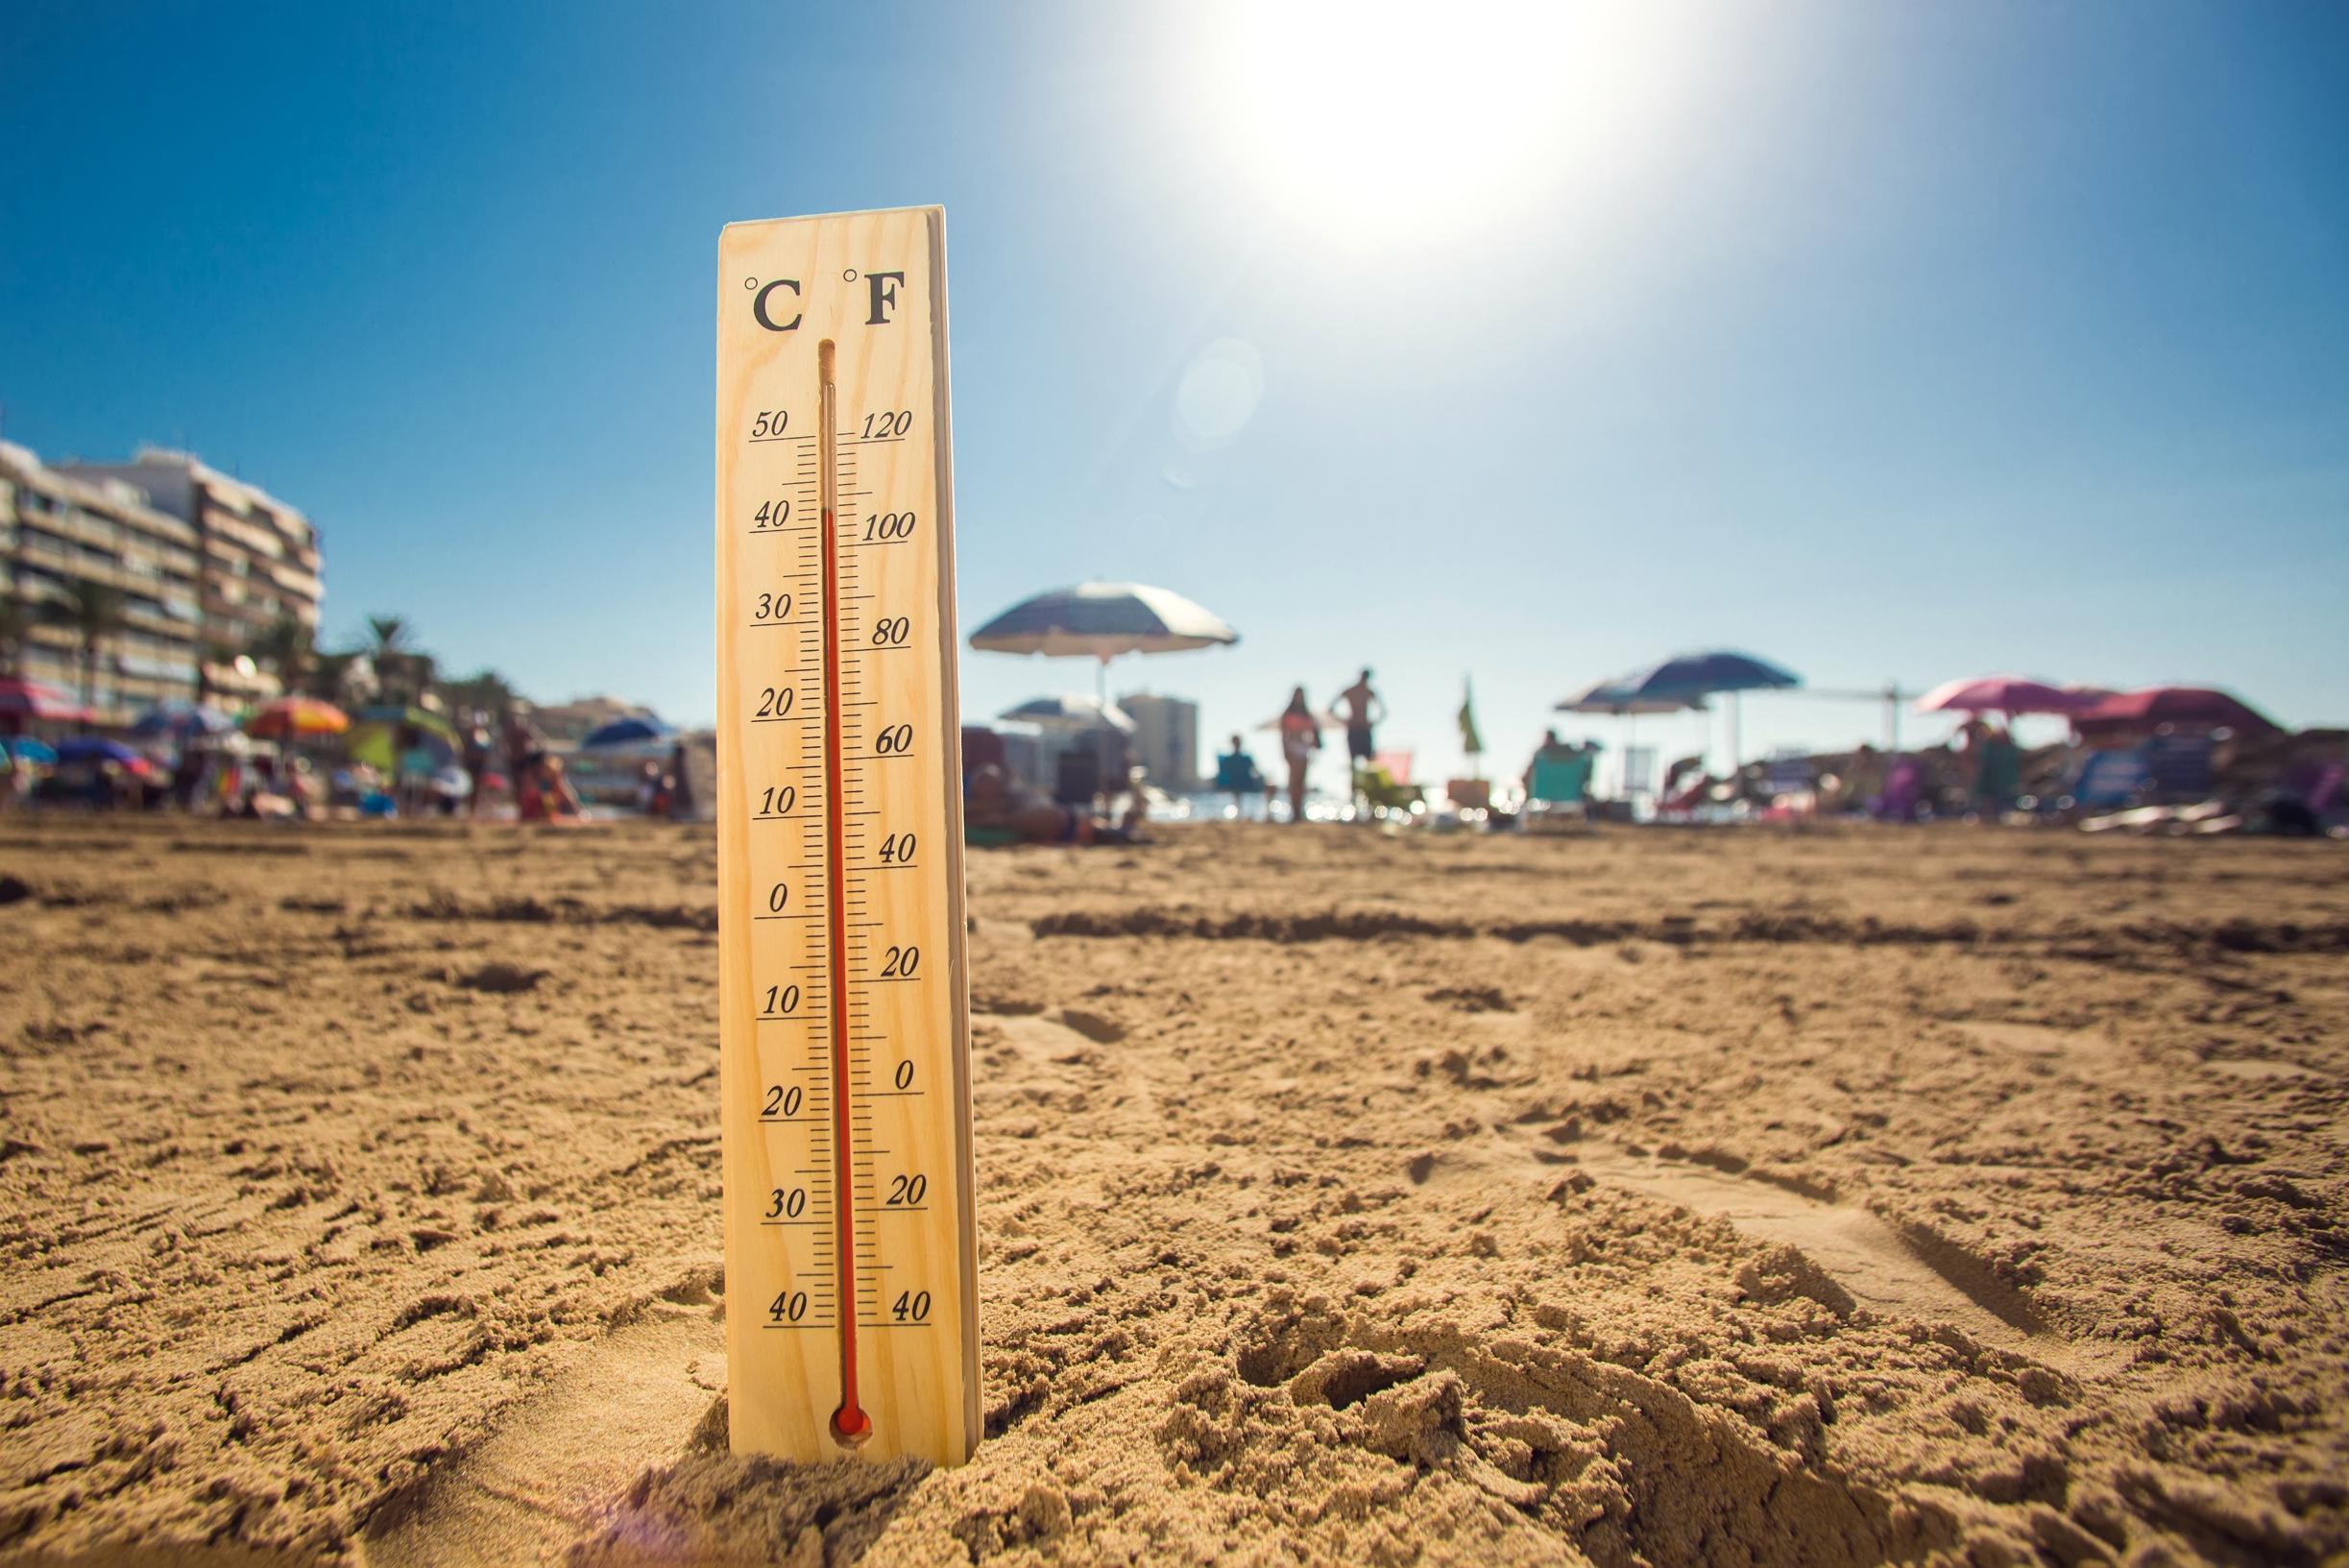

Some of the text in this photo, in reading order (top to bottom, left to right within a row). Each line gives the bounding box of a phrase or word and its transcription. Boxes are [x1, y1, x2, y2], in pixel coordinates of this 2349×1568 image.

[752, 410, 788, 438] 50
[860, 410, 912, 439] 120
[754, 499, 789, 528] 40
[862, 512, 916, 542] 100
[755, 592, 791, 619] 30
[871, 616, 909, 645] 80
[756, 688, 793, 717] 20
[875, 724, 913, 755] 60
[760, 785, 795, 815] 10
[878, 832, 916, 863] 40
[769, 882, 788, 913] 0
[880, 946, 920, 977] 20
[763, 984, 800, 1014] 10
[894, 1059, 914, 1091] 0
[761, 1085, 802, 1117] 20
[764, 1188, 806, 1218] 30
[885, 1173, 927, 1206] 20
[768, 1291, 808, 1322] 40
[891, 1290, 932, 1322] 40
